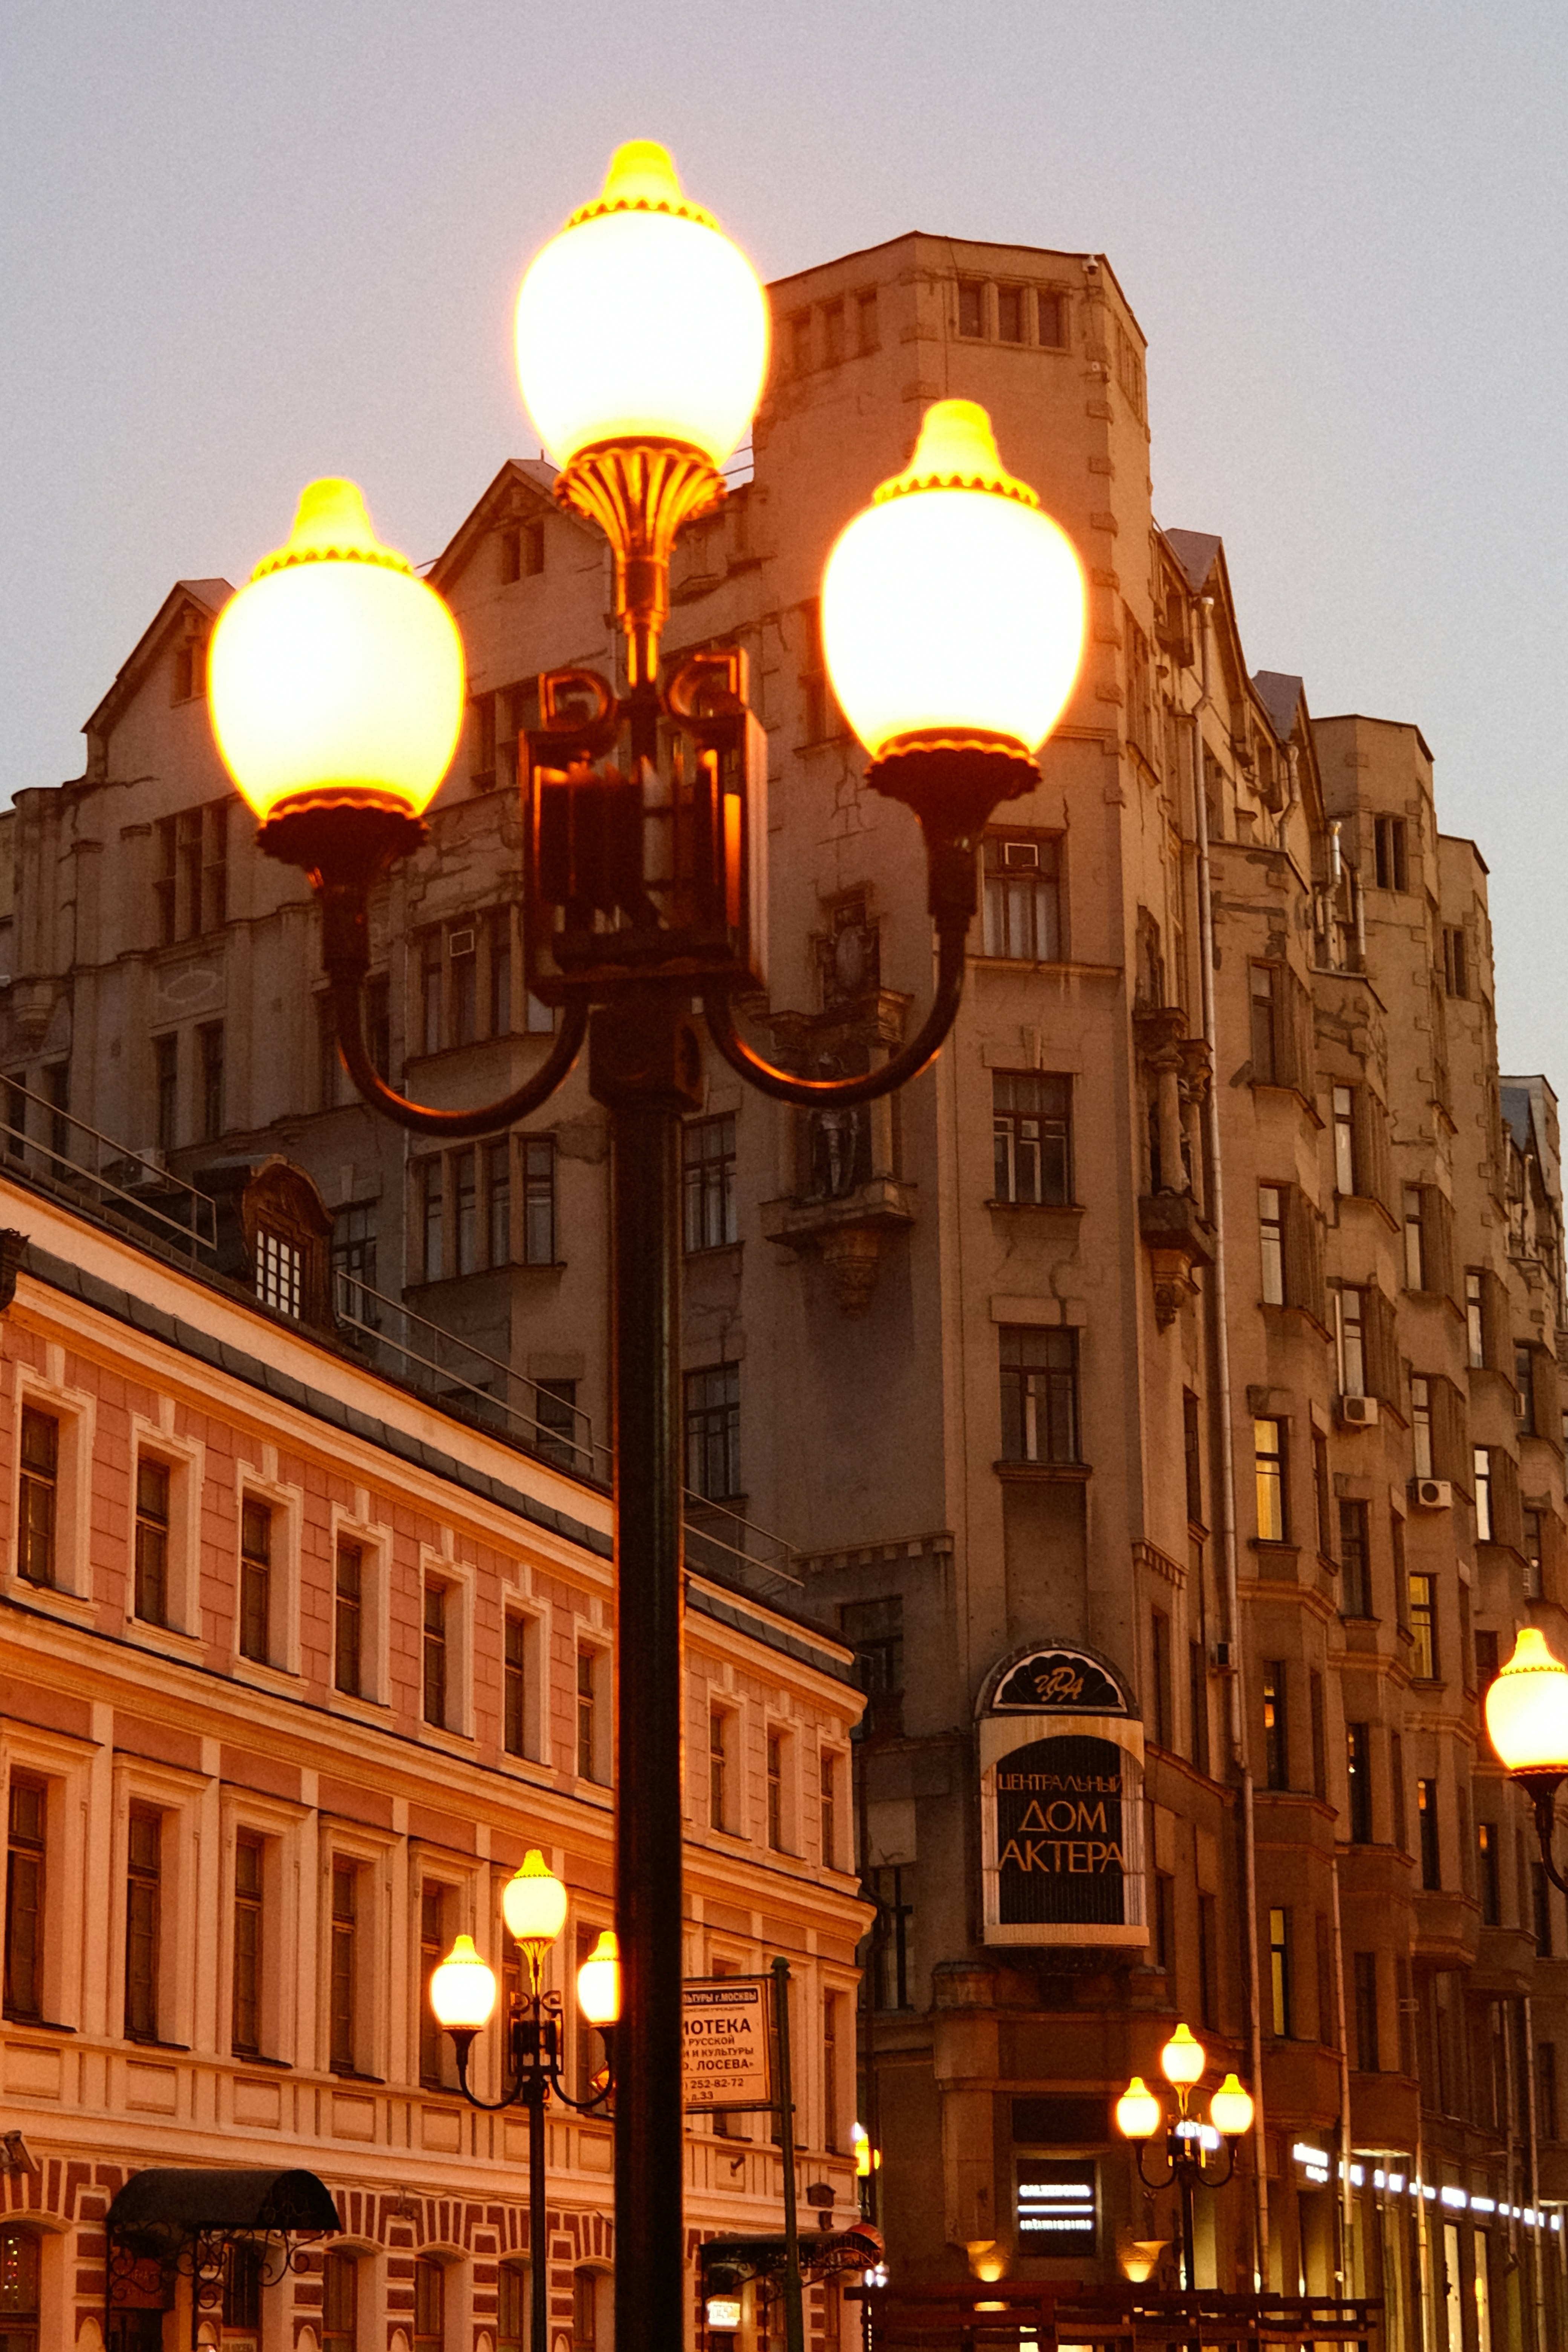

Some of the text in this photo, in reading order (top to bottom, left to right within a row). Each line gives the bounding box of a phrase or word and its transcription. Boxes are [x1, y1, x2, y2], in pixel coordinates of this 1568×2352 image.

[998, 1773, 1122, 1793] ЦЕНТРАЛЬНЫЙ
[1018, 1800, 1107, 1833] ДОМ
[998, 1839, 1126, 1873] АКТЕРА
[683, 1993, 713, 2003] ЛЬТУРЫ
[689, 2035, 735, 2046] РУССКОЙ
[701, 2047, 753, 2057] КУЛЬТУРЫ
